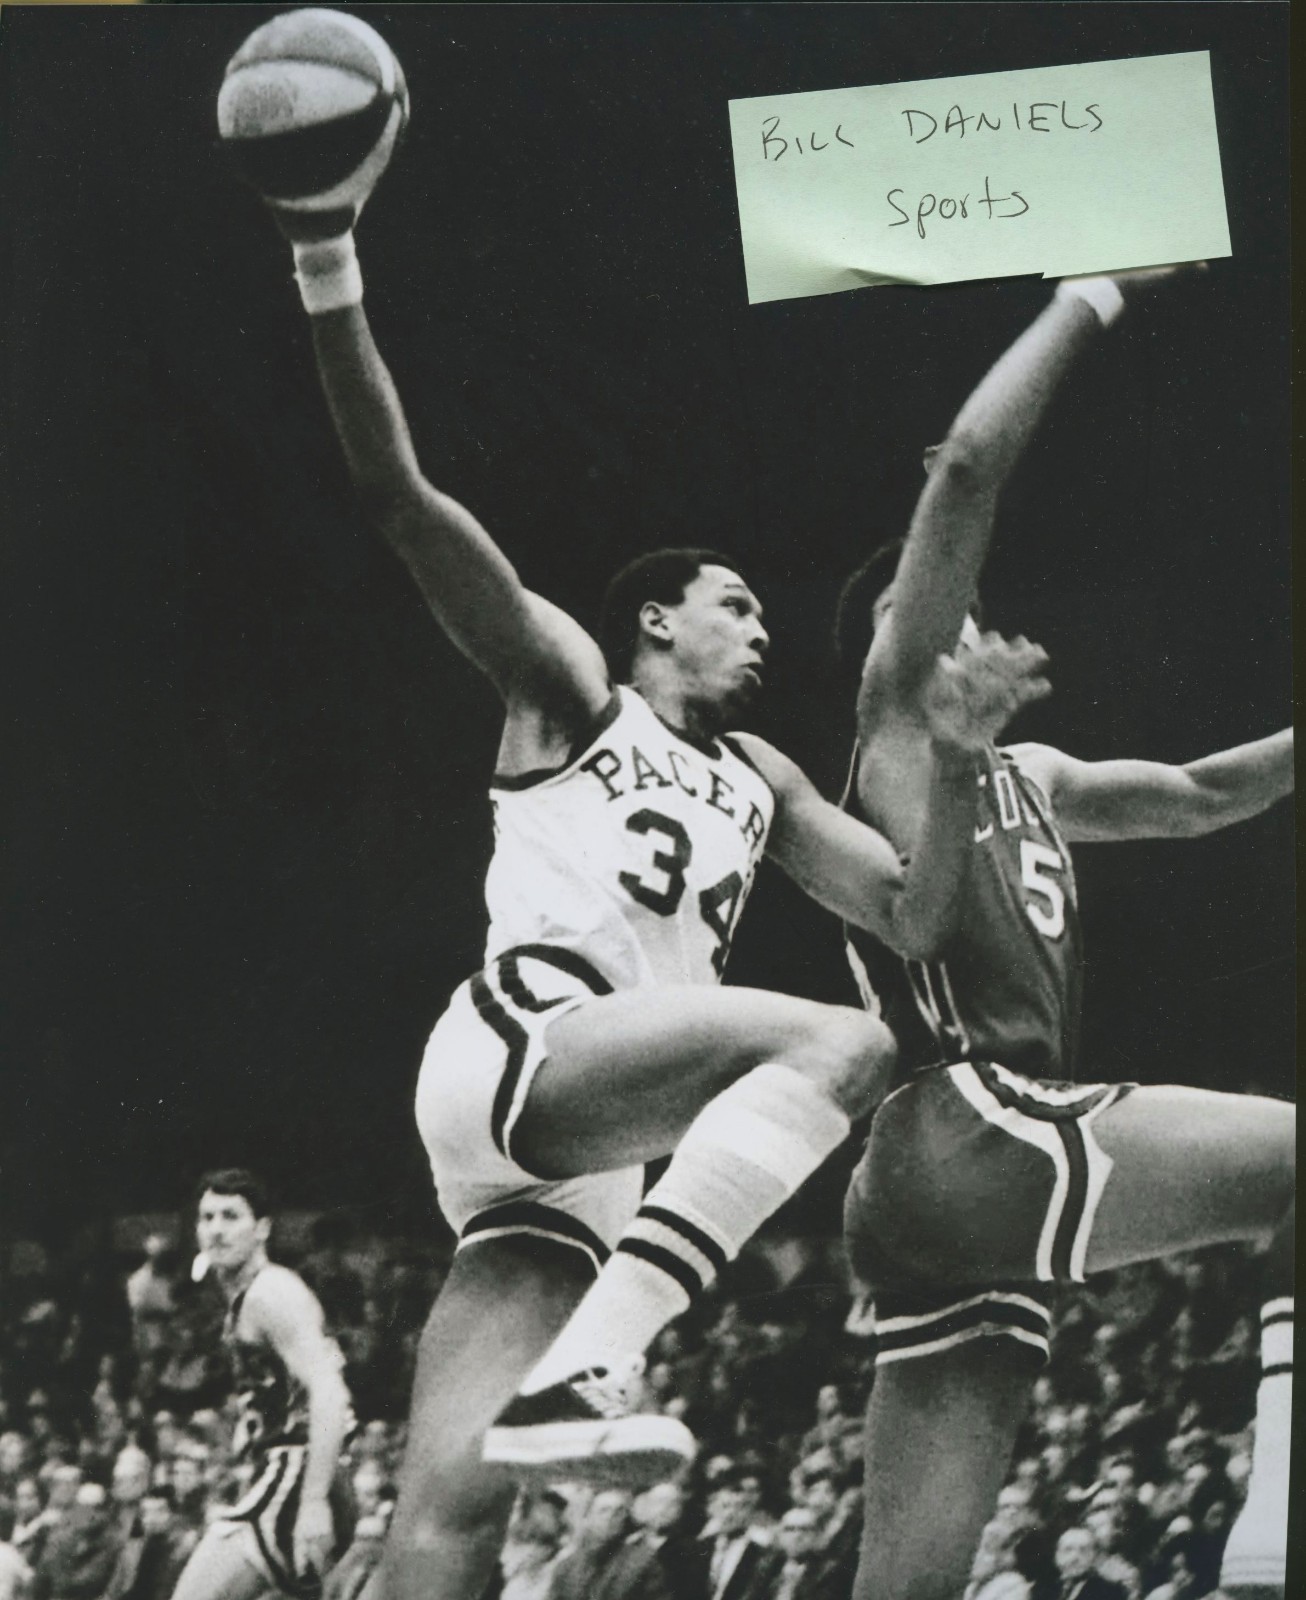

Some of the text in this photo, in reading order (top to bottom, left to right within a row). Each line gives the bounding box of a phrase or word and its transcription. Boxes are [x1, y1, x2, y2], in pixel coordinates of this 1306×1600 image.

[761, 101, 1103, 161] BILL DANIELS
[1020, 838, 1065, 938] 5
